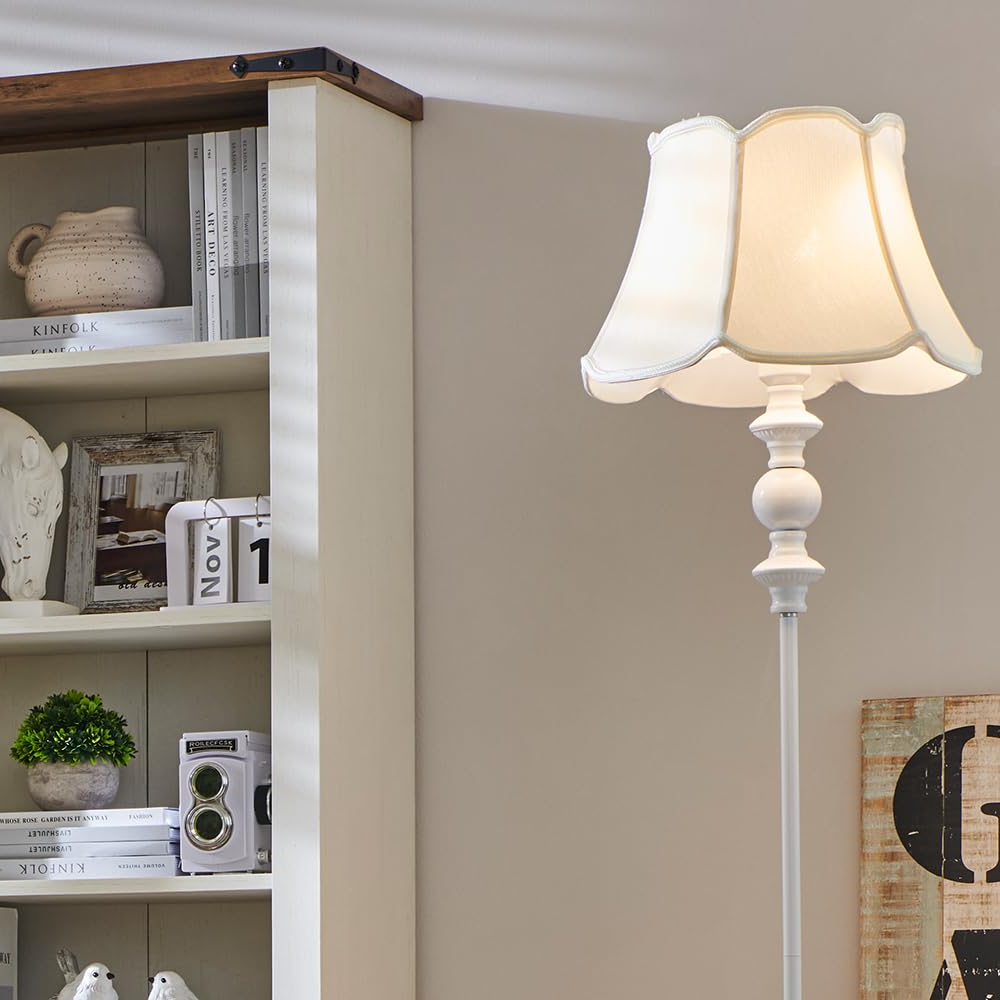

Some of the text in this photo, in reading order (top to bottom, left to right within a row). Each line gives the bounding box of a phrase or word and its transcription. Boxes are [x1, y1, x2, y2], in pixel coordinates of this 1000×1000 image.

[208, 242, 216, 276] DECO
[32, 321, 100, 337] KINFOLK
[40, 816, 66, 824] GARDEN
[28, 830, 72, 838] LIVSHJULET
[28, 846, 72, 854] LIVSHJULET
[18, 862, 86, 874] KINFOLK
